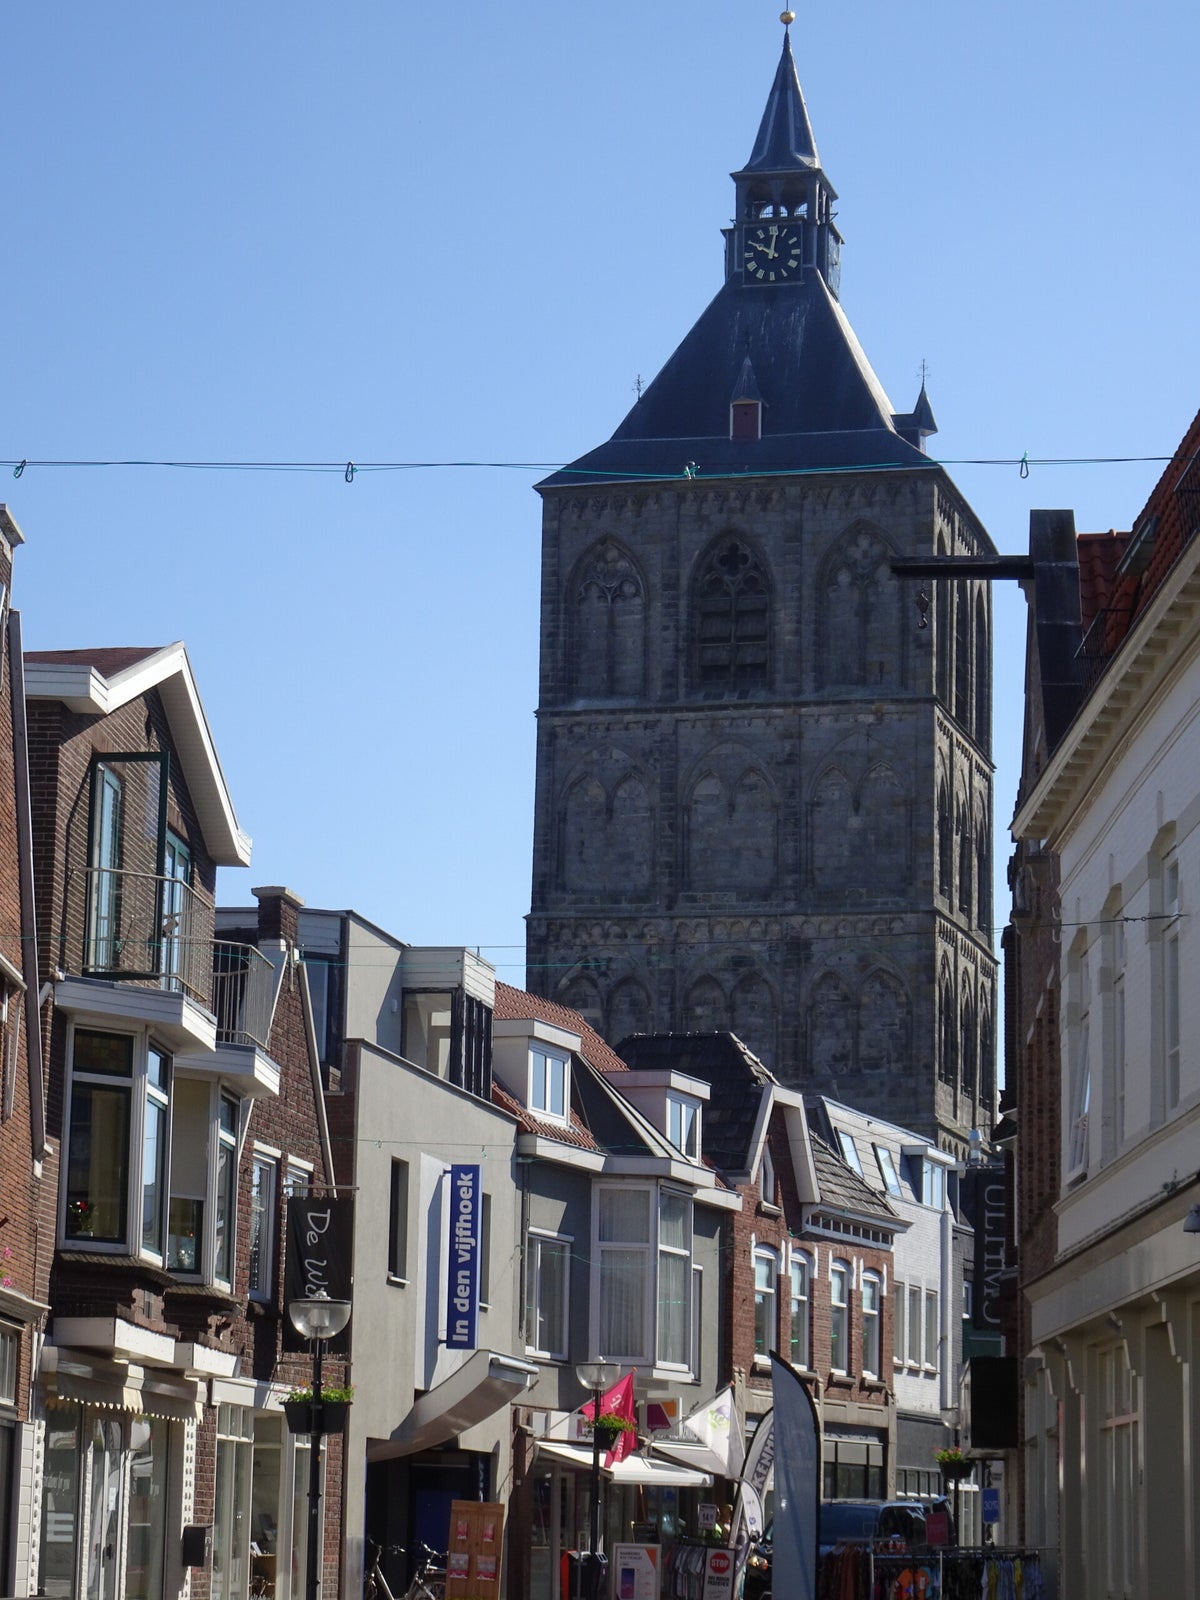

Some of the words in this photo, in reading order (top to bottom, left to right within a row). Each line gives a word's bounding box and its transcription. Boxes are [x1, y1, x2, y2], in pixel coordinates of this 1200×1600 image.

[306, 1208, 331, 1247] De
[455, 1172, 476, 1264] vijfhoek
[453, 1270, 471, 1312] den
[452, 1319, 469, 1342] In
[710, 1558, 730, 1568] STOP
